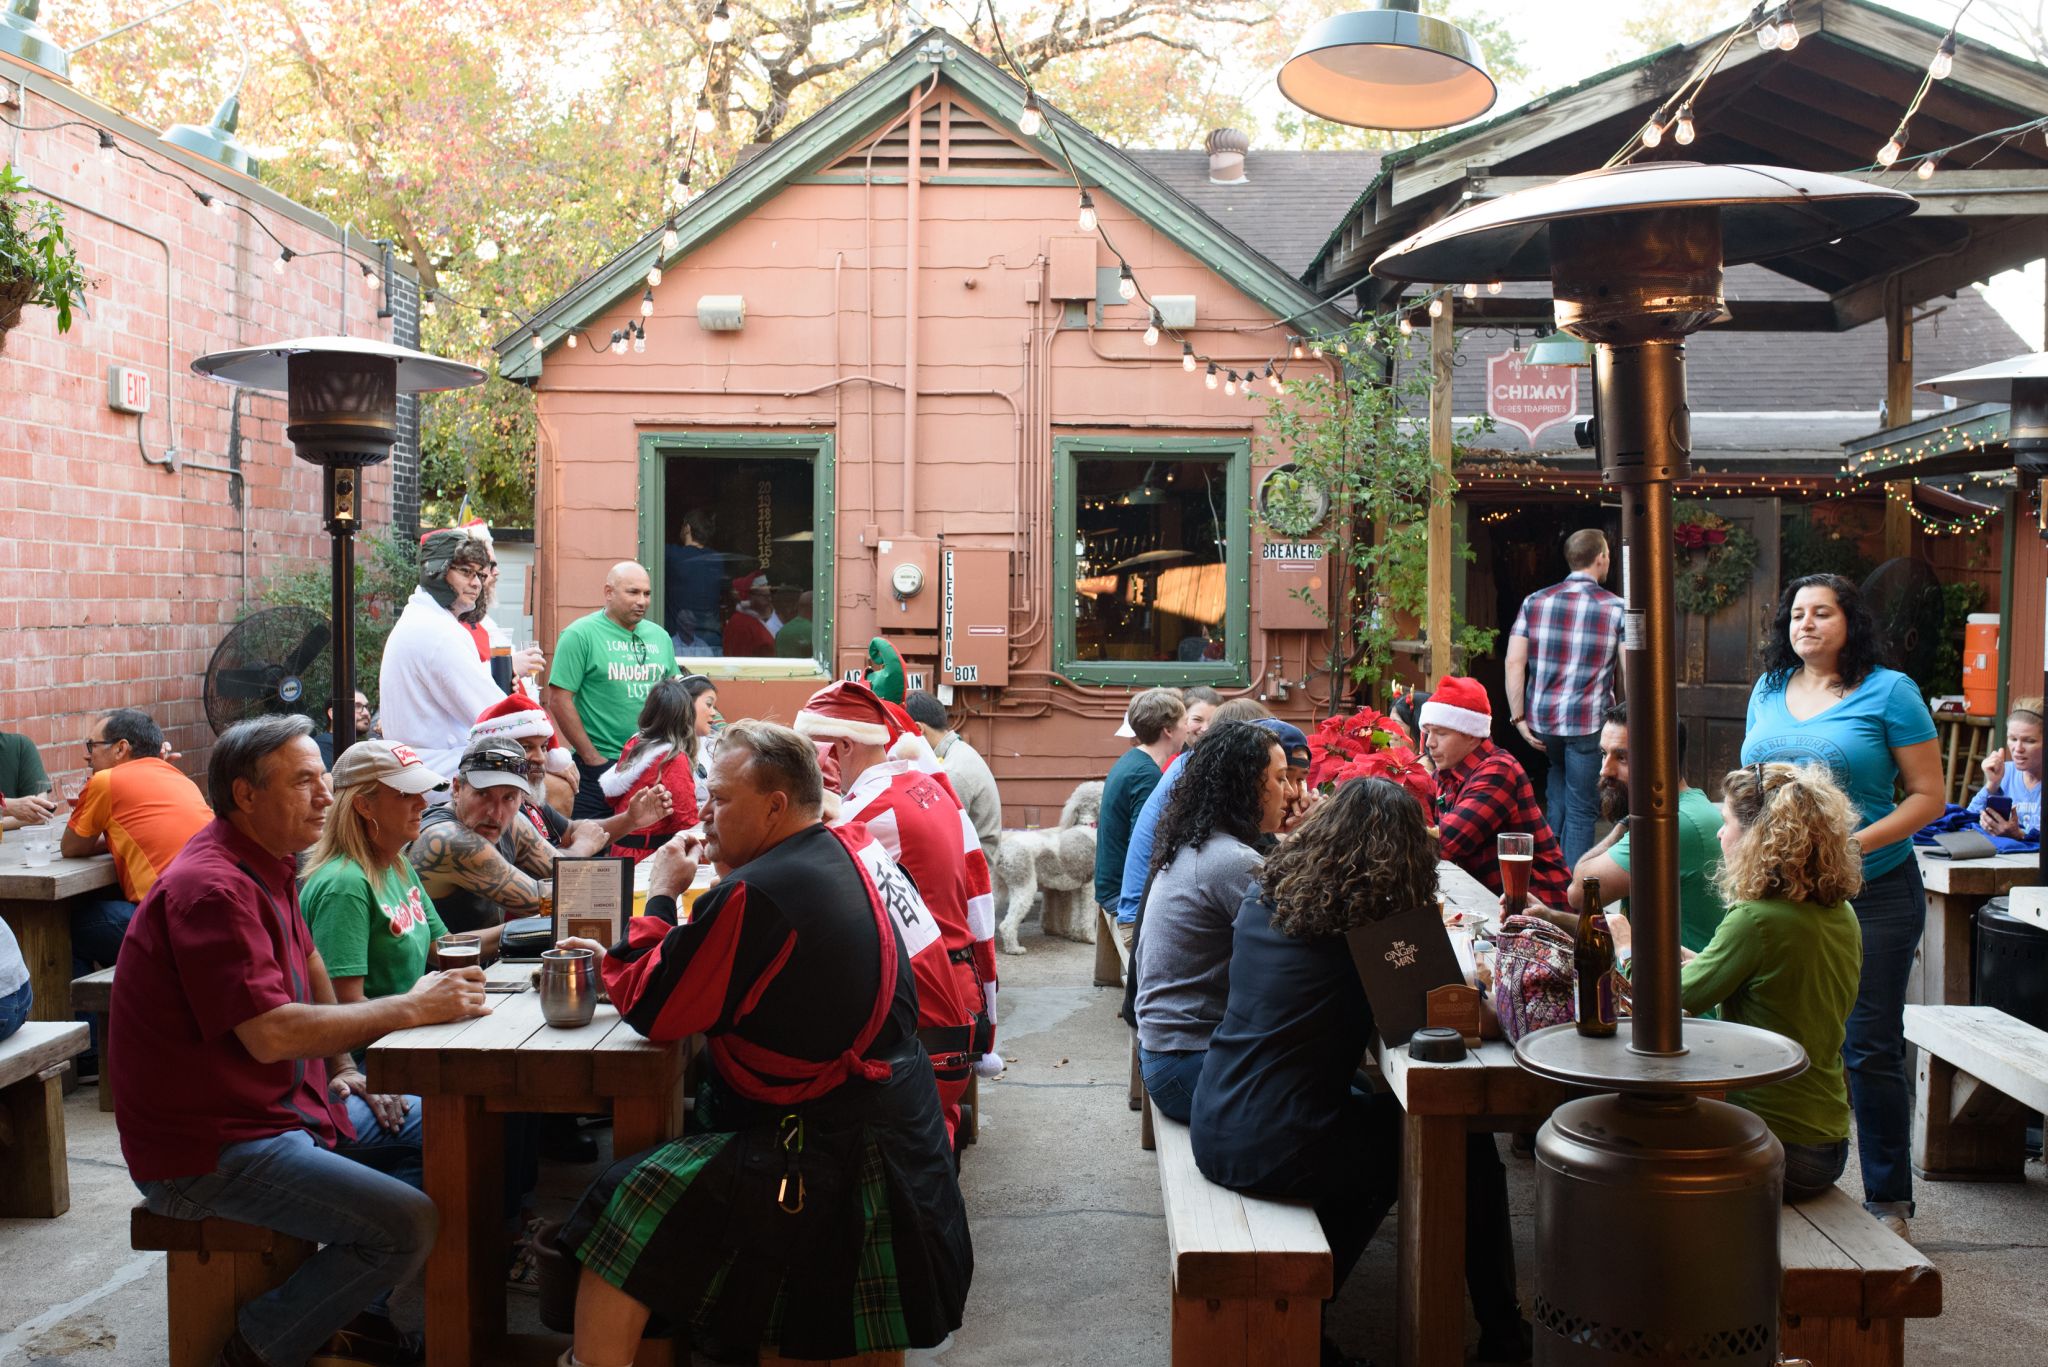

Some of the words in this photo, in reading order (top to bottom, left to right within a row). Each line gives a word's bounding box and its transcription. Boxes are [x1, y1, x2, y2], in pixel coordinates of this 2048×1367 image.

[127, 372, 147, 408] EXIT
[1494, 384, 1571, 400] CHIMAY
[1524, 404, 1567, 414] TRAPPISTES
[758, 546, 773, 558] 15
[945, 551, 953, 671] ELECTRIC
[955, 666, 976, 681] BOX
[607, 662, 665, 681] NAUGHTY
[846, 670, 861, 682] AC
[627, 683, 651, 698] LIST
[1796, 737, 1829, 752] WORK
